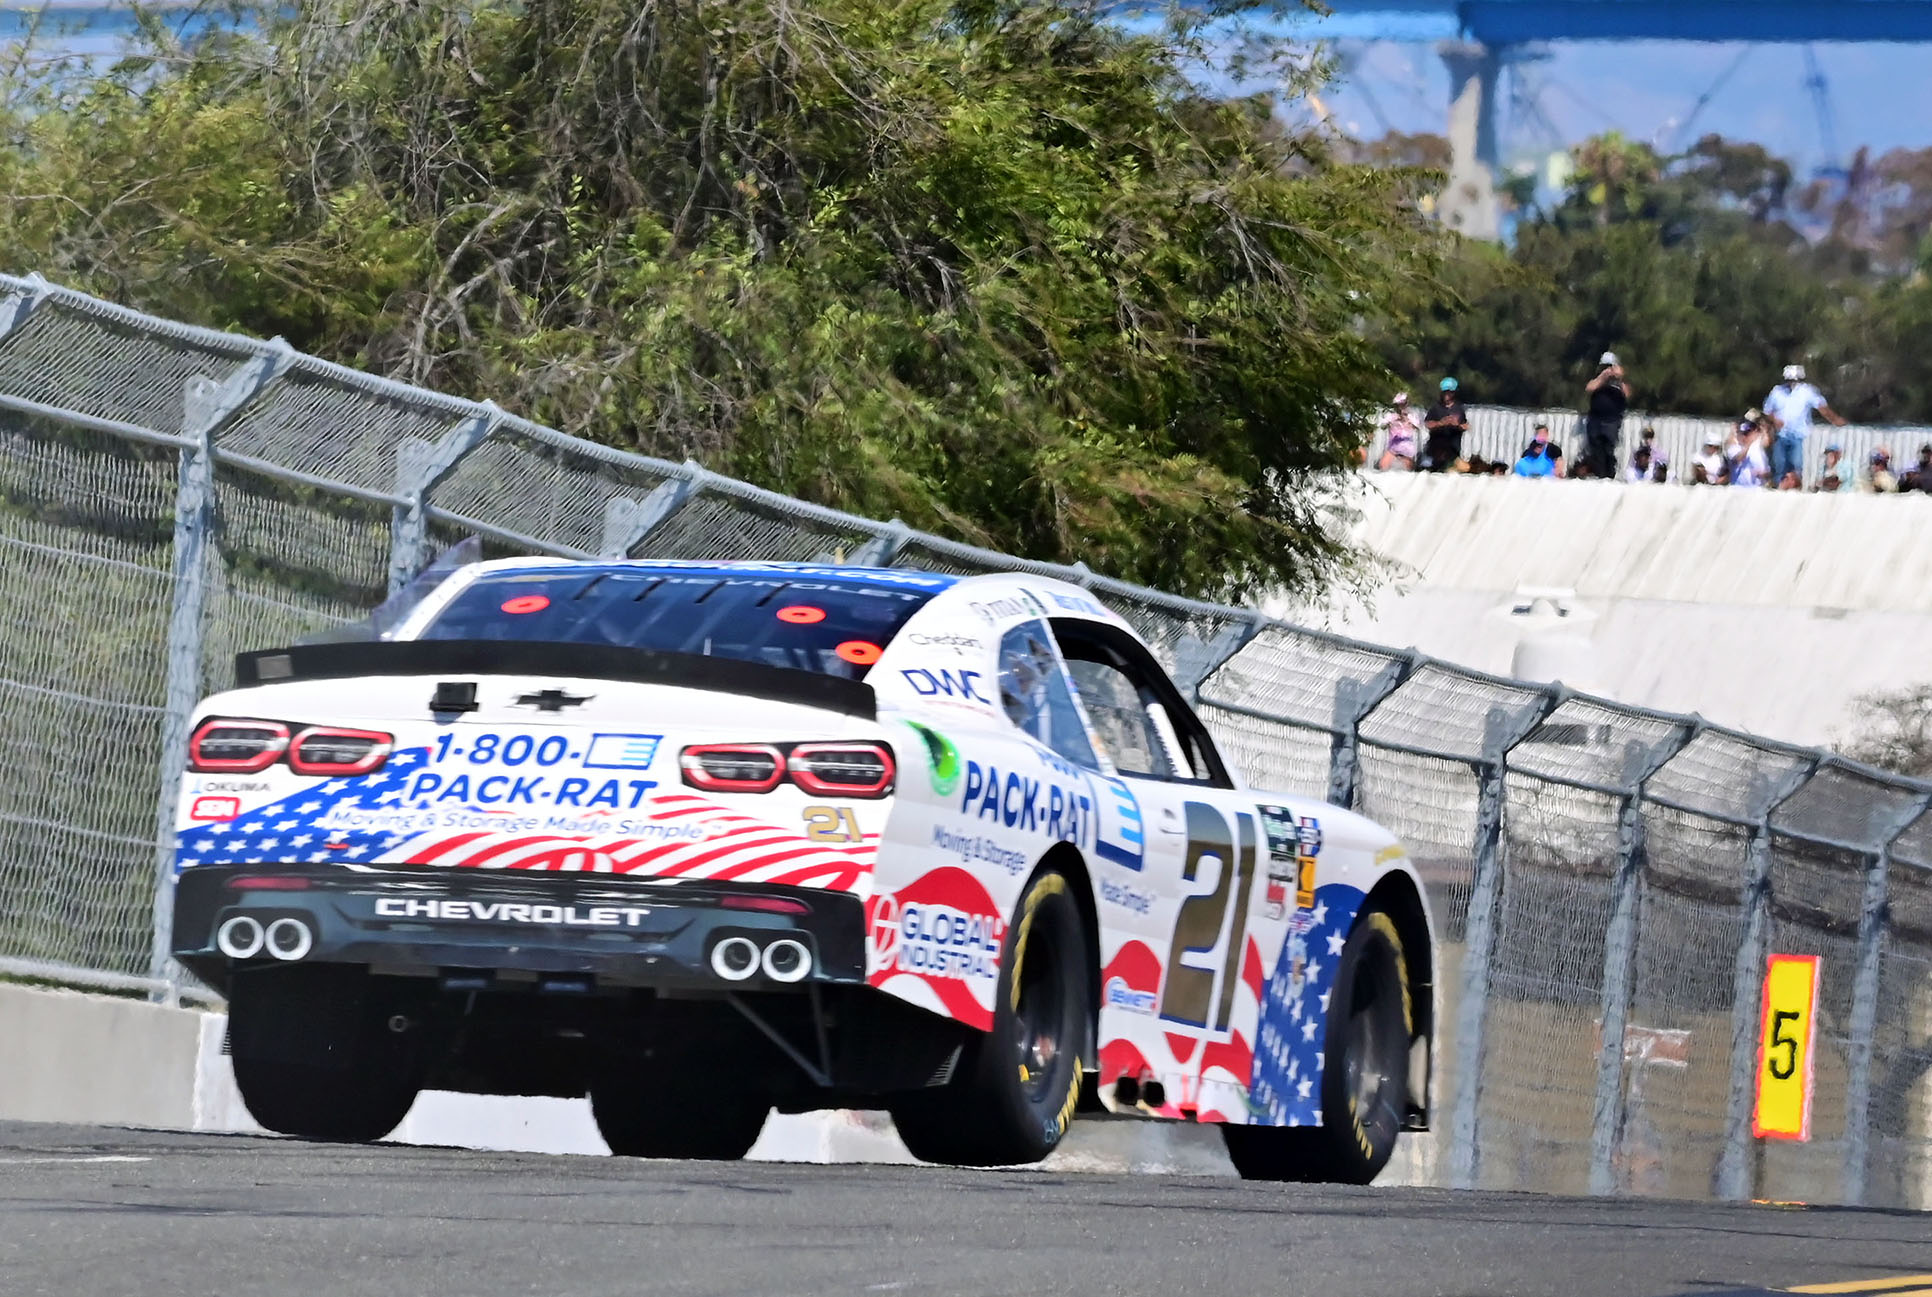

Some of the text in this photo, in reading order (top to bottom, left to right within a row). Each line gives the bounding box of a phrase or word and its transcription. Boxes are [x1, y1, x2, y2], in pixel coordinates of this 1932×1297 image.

[900, 668, 991, 705] DWC
[409, 773, 659, 808] PACK-RAT
[961, 760, 1090, 850] PACK-RAT
[442, 812, 539, 834] Storage
[542, 816, 611, 834] Made
[615, 819, 705, 840] Simple
[802, 805, 863, 843] 21
[374, 897, 650, 927] CHEVROLET
[902, 907, 997, 952] GLOBAL
[1158, 800, 1257, 1033] 21
[1769, 1010, 1800, 1080] 5
